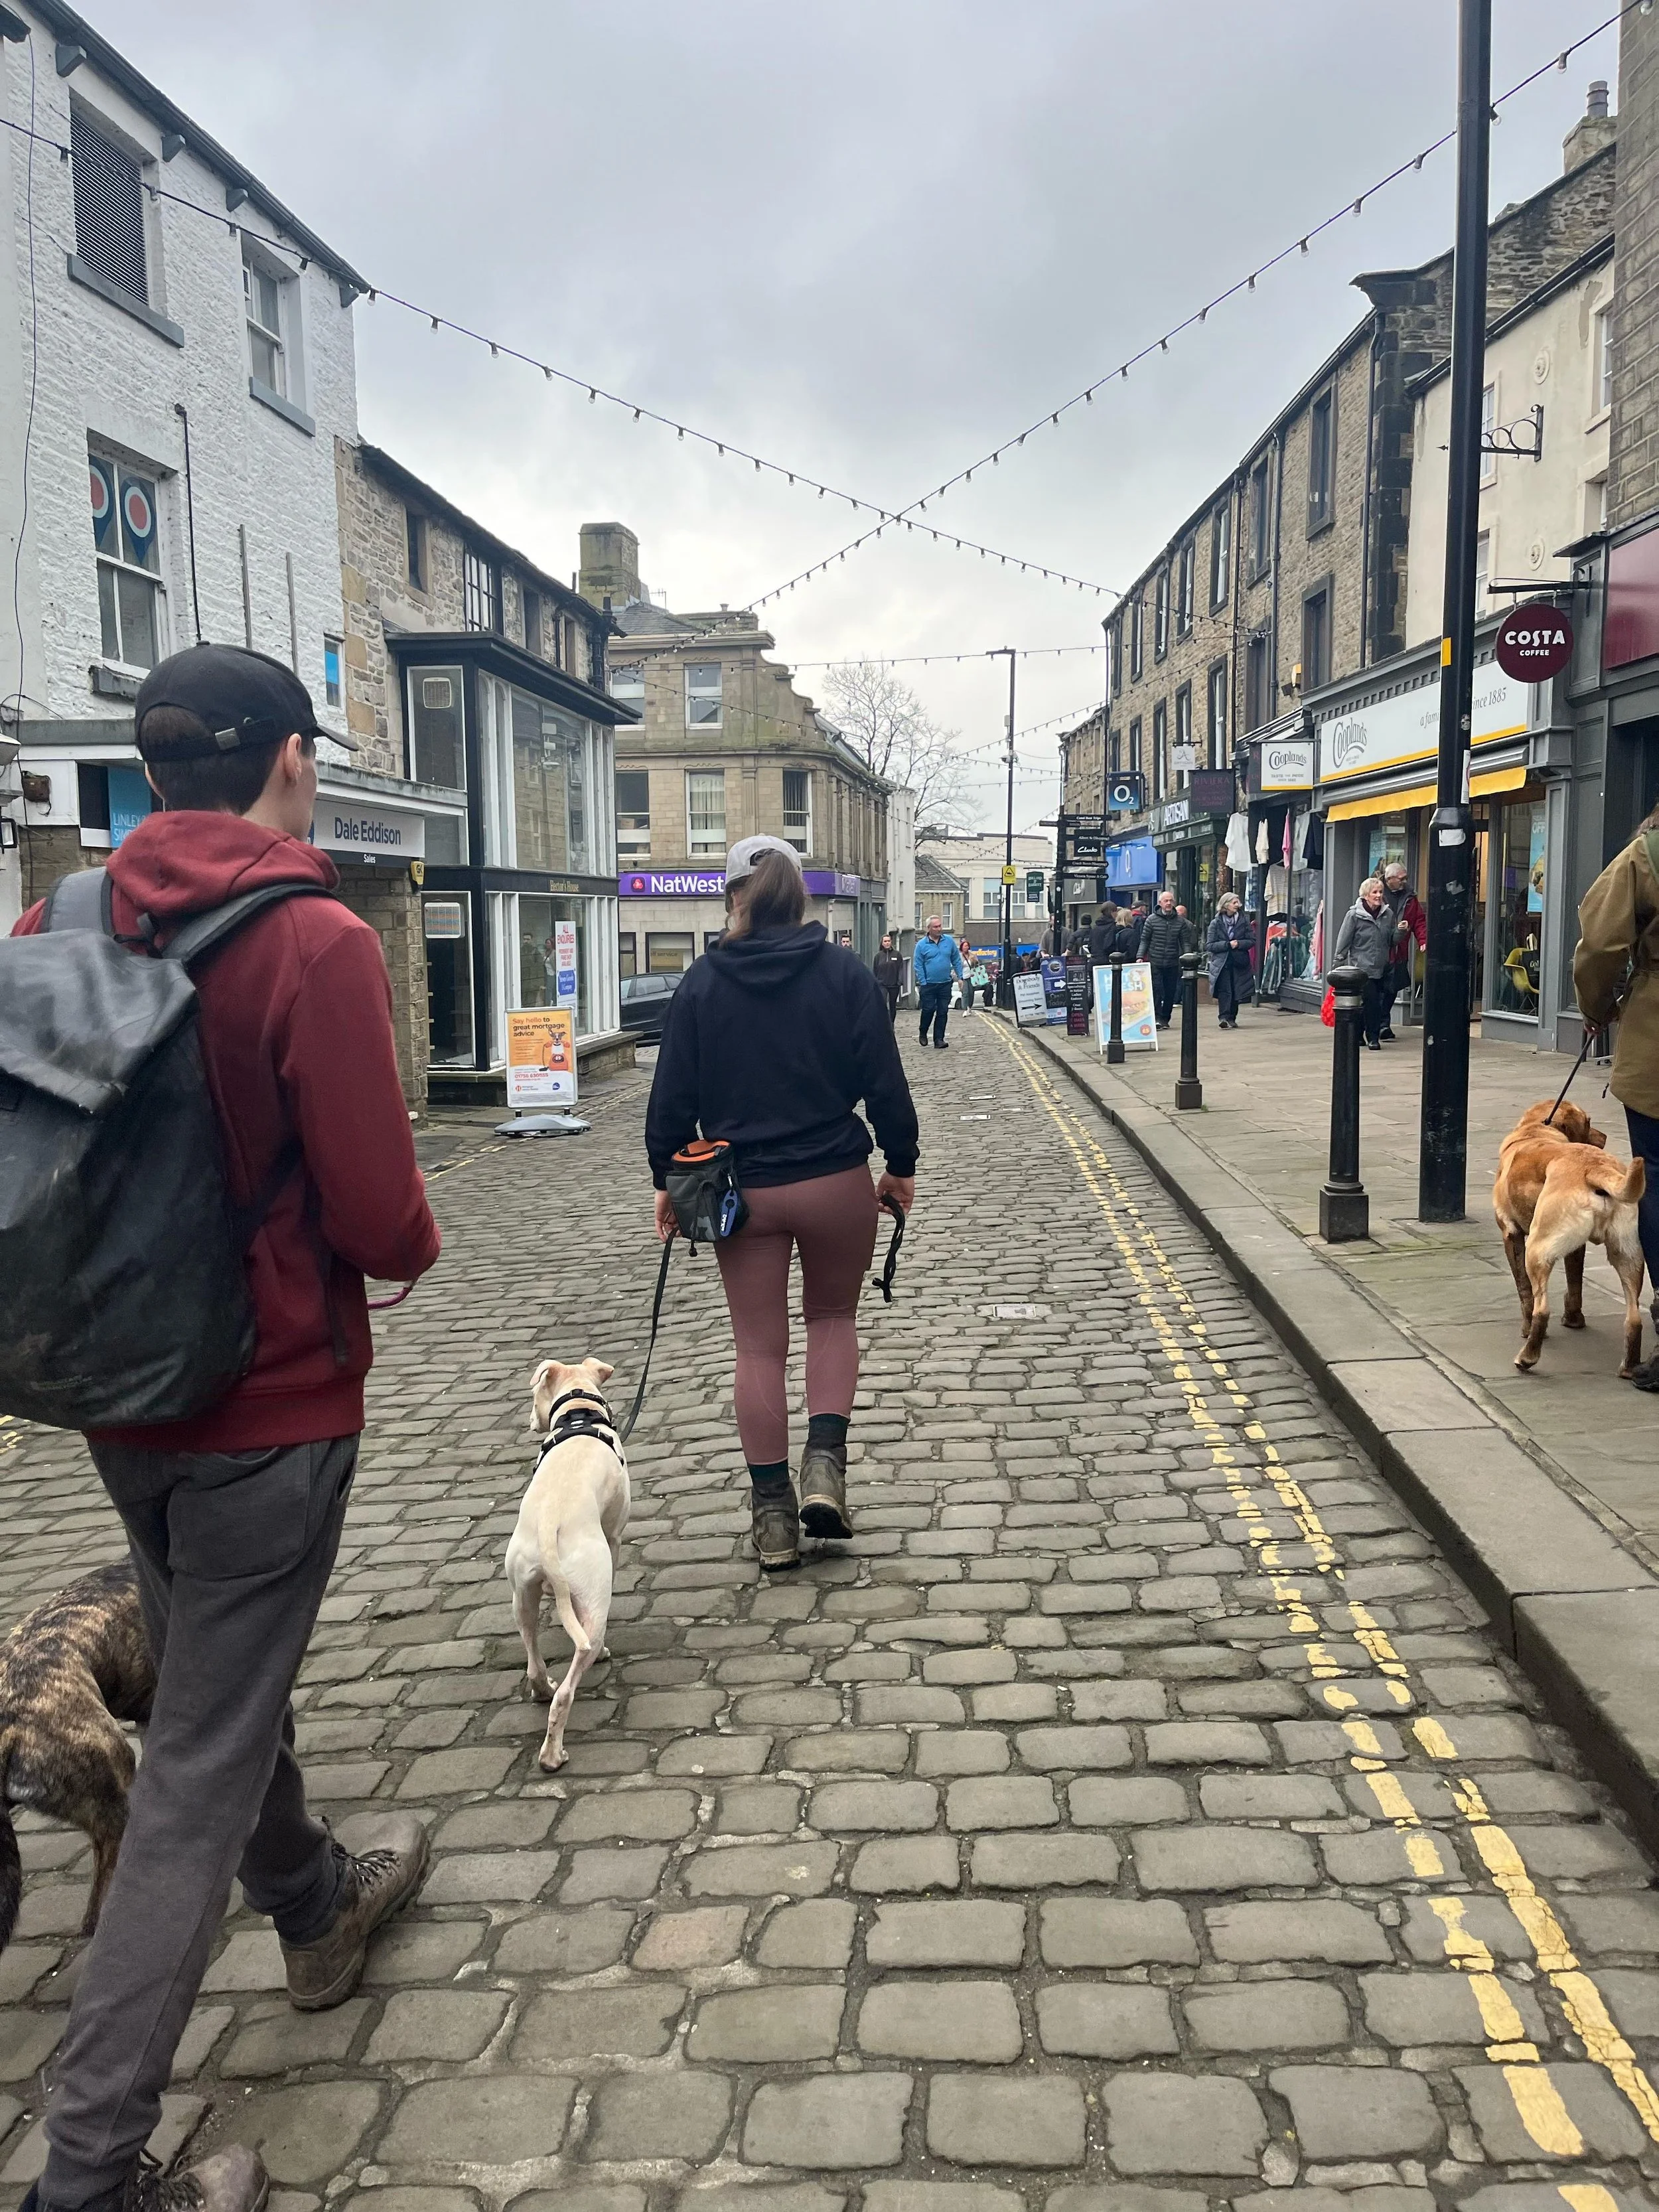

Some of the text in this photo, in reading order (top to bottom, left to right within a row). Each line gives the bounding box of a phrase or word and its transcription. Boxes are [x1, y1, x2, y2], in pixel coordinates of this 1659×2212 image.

[1505, 630, 1565, 647] COSTA
[1424, 709, 1439, 729] fami
[1472, 696, 1487, 710] ince
[1488, 687, 1506, 705] 1885
[1333, 717, 1367, 769] Cooplands
[1269, 751, 1307, 770] Cooplands
[1114, 785, 1134, 804] O2
[1164, 799, 1189, 827] ARTISAN
[334, 817, 401, 846] Dale Eddison
[1532, 822, 1546, 834] OFF
[364, 853, 376, 863] Sales
[567, 881, 579, 892] House
[651, 875, 724, 893] NatWest
[557, 934, 575, 944] ENQUIRIES
[1104, 973, 1130, 984] HT
[1105, 981, 1143, 994] FESH
